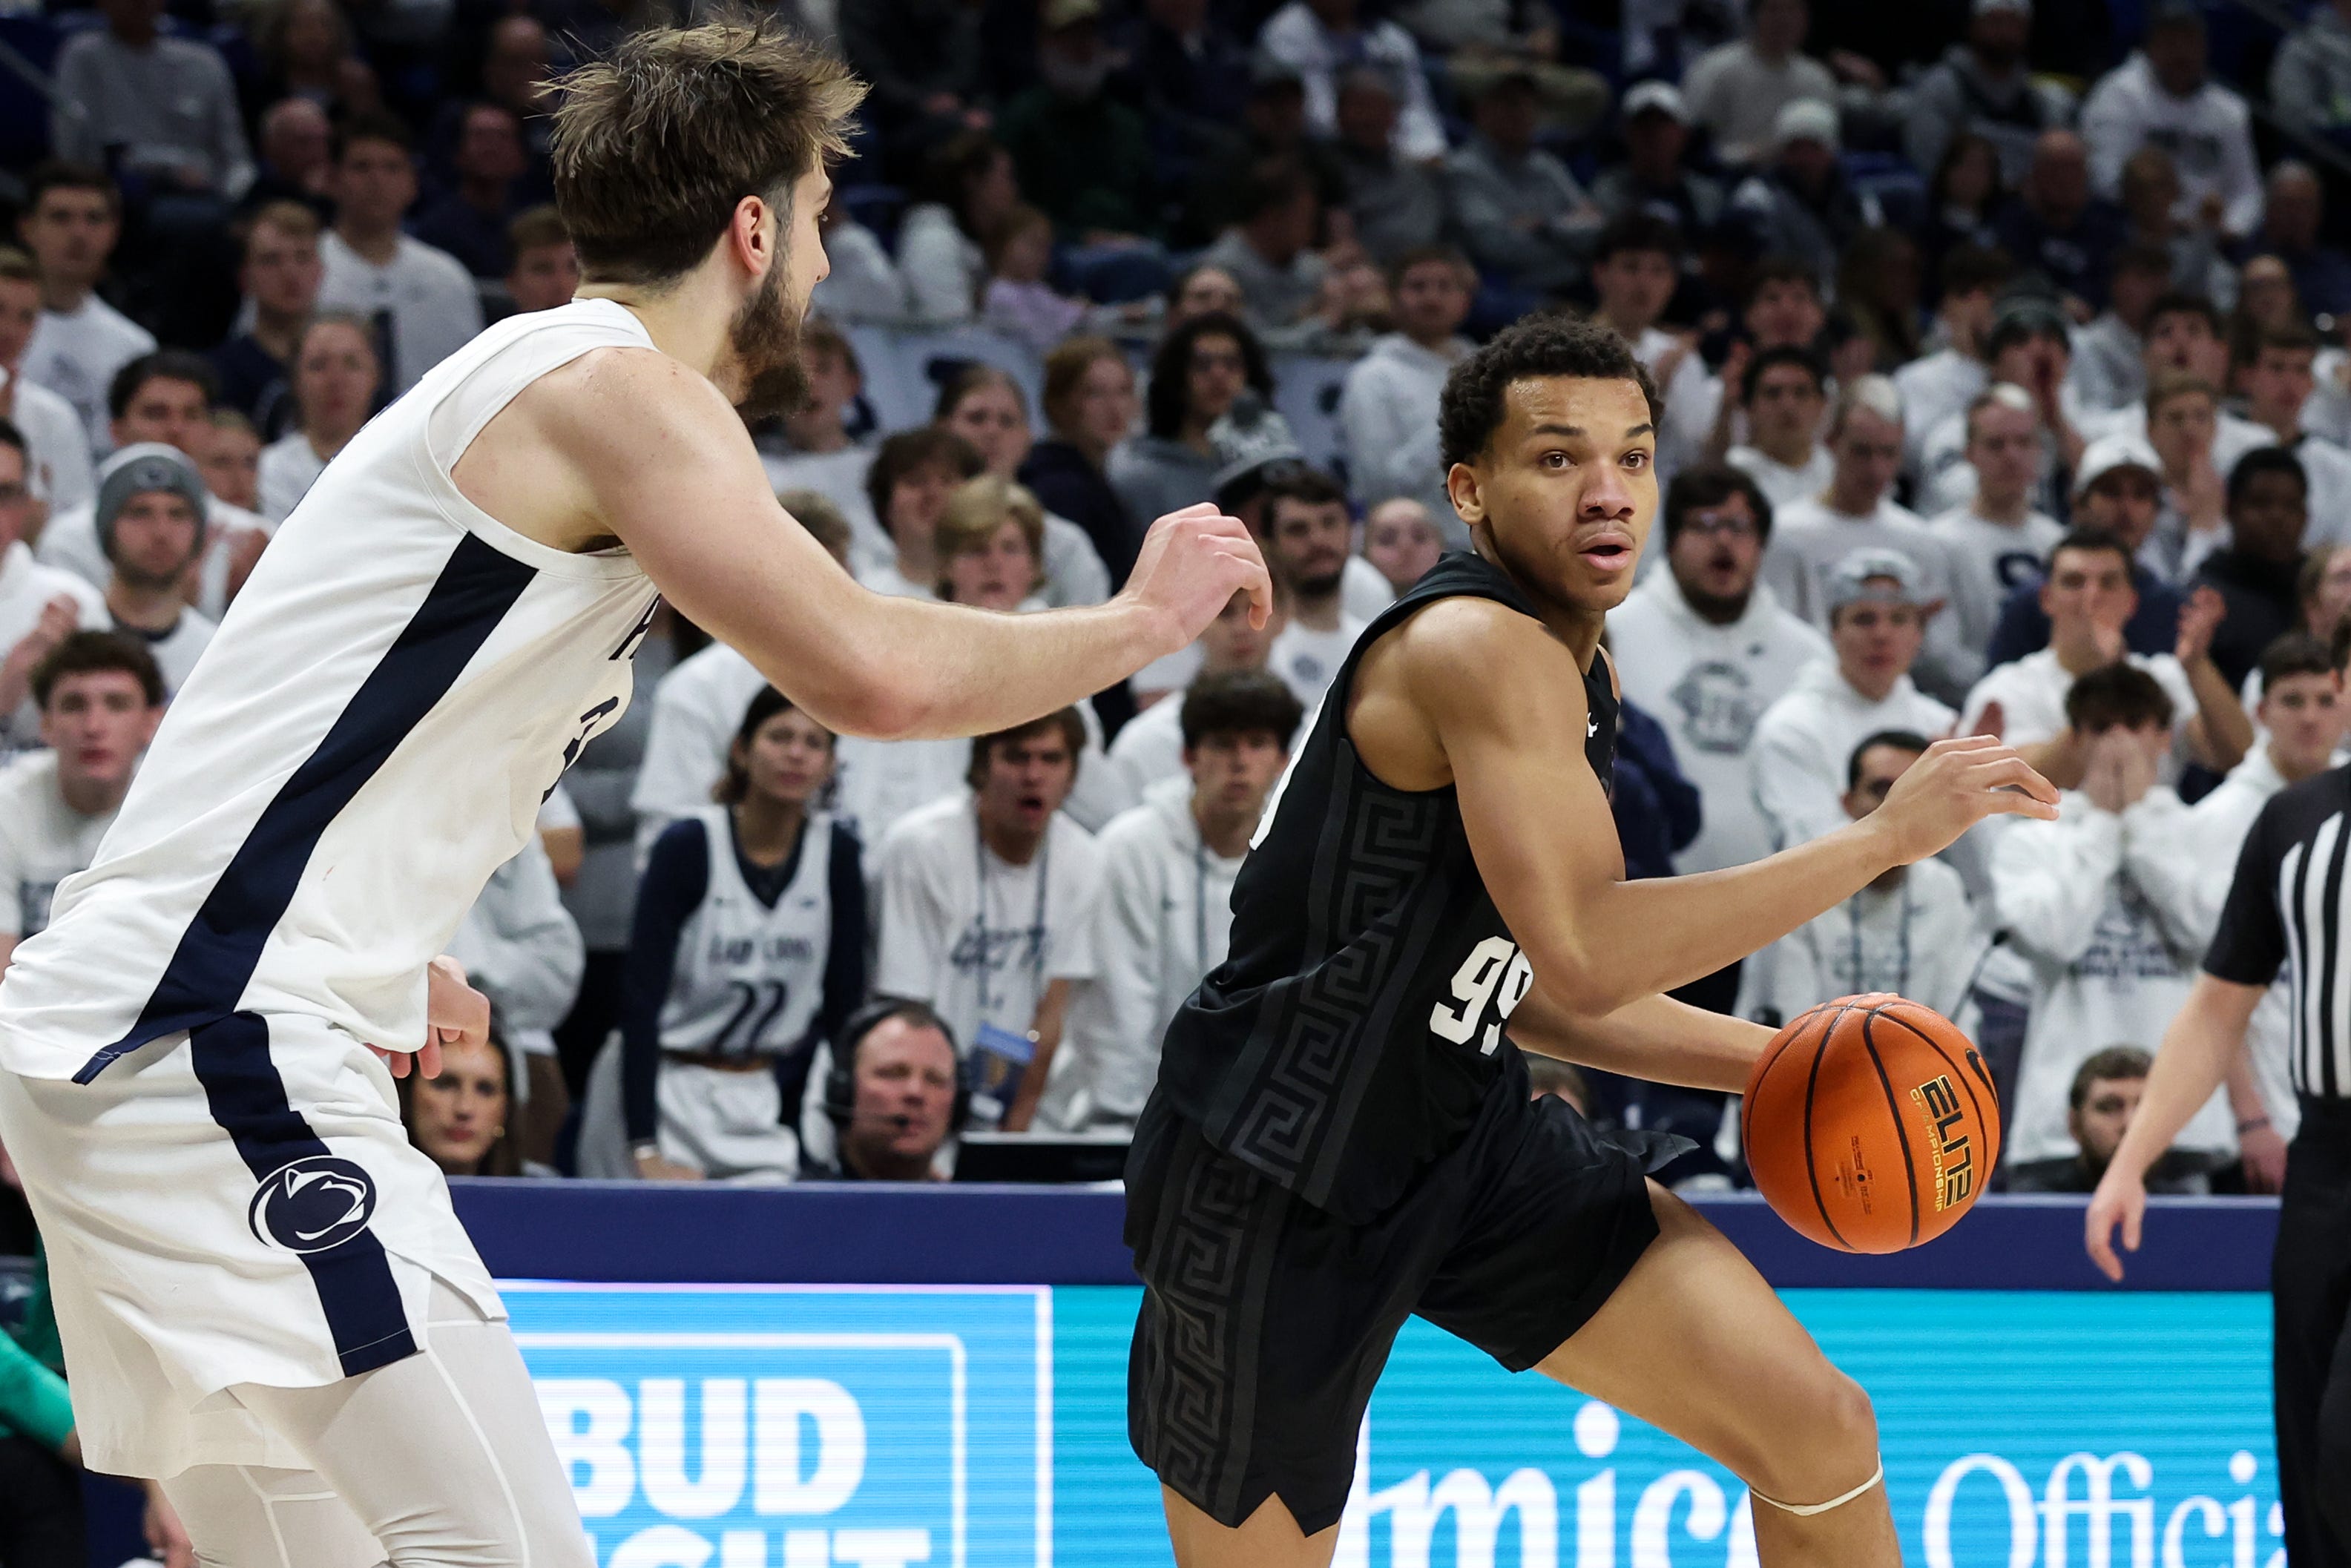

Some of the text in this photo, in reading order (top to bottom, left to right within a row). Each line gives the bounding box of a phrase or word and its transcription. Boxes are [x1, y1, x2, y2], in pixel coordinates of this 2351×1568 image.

[1429, 935, 1534, 1056] 99
[1910, 1088, 1946, 1213] CHAMPIONSHIP
[530, 1377, 867, 1519] BUD
